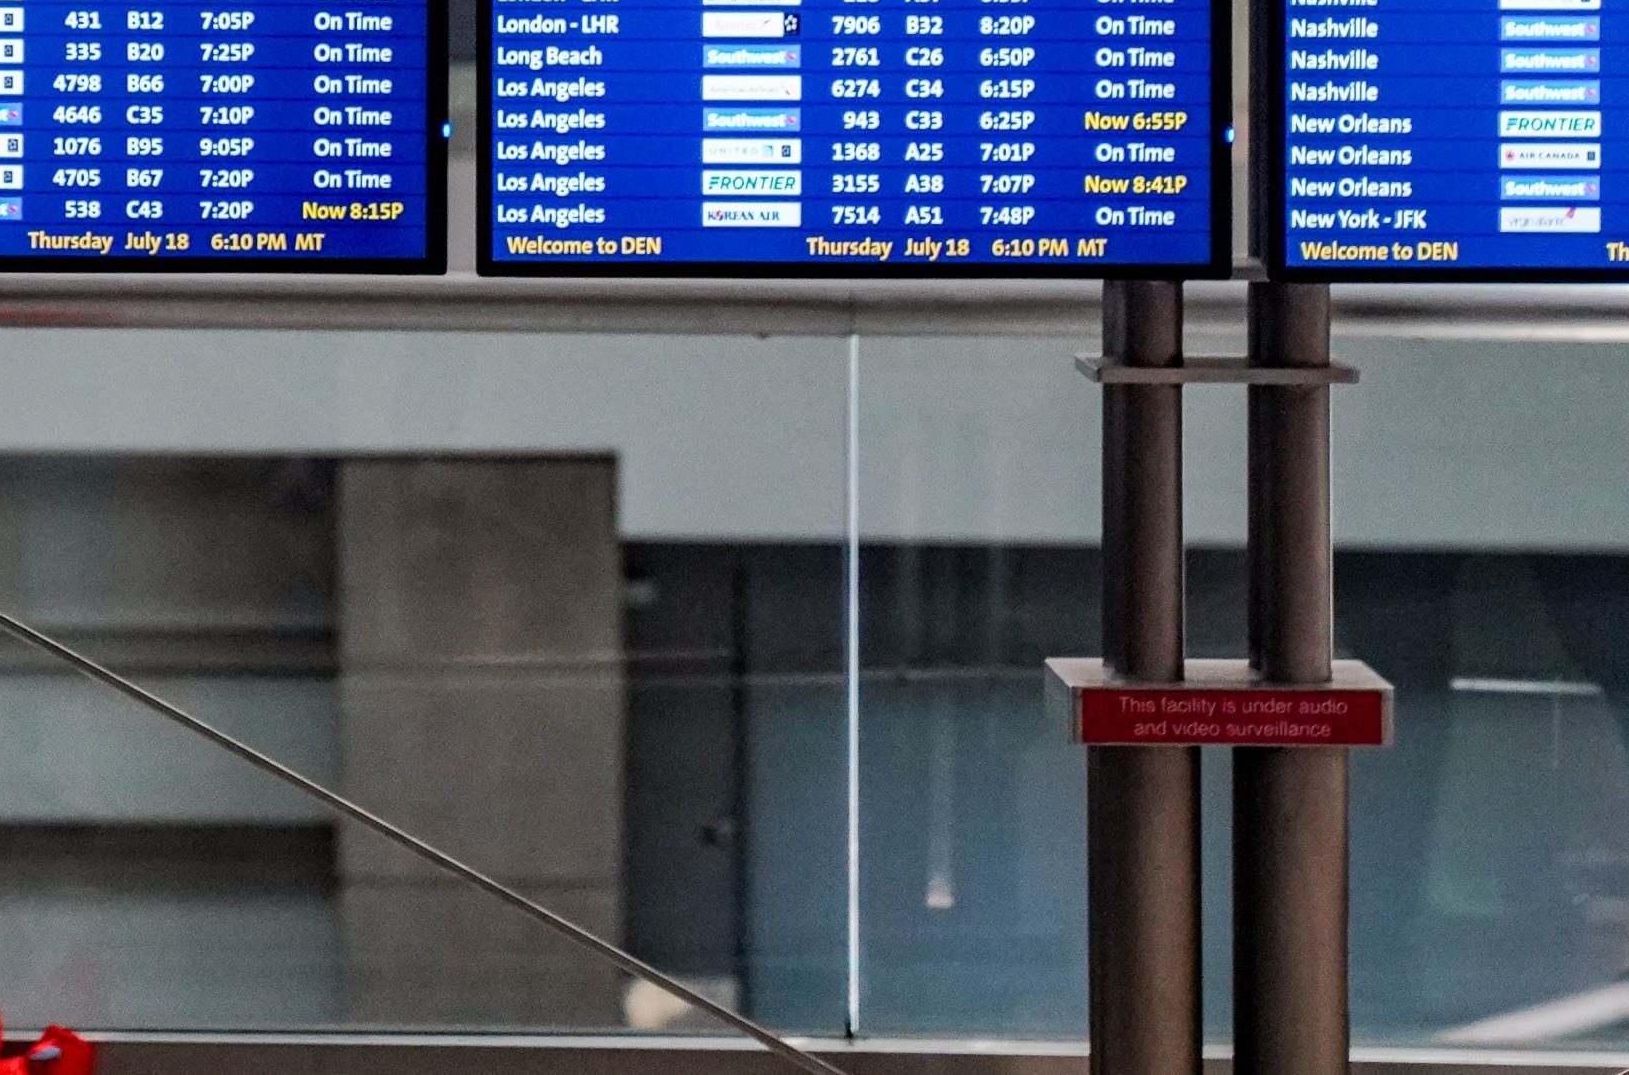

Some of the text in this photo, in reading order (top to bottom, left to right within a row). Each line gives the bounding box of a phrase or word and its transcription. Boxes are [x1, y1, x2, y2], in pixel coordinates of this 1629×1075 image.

[53, 106, 101, 123] 4646
[127, 106, 162, 123] C35
[200, 107, 253, 124] 7:10P
[314, 108, 342, 124] On
[345, 107, 391, 125] Time
[1292, 113, 1595, 133] New Orleans FRONTIER
[498, 205, 527, 222] Los
[531, 204, 605, 228] Angeles
[832, 207, 880, 224] 7514
[905, 206, 943, 224] A51
[981, 207, 1034, 224] 7:48P
[1096, 207, 1124, 225] On
[1128, 207, 1174, 225] Time
[28, 231, 324, 254] Thursday July 18 6:10 PM MT
[507, 236, 661, 254] Welcome to DEN
[806, 237, 1107, 261] Thursday July 18 6:10 PM MT
[1301, 241, 1458, 260] Welcome to DEN
[1120, 697, 1348, 717] This facility is under audio
[1134, 720, 1331, 737] and video surveillance
